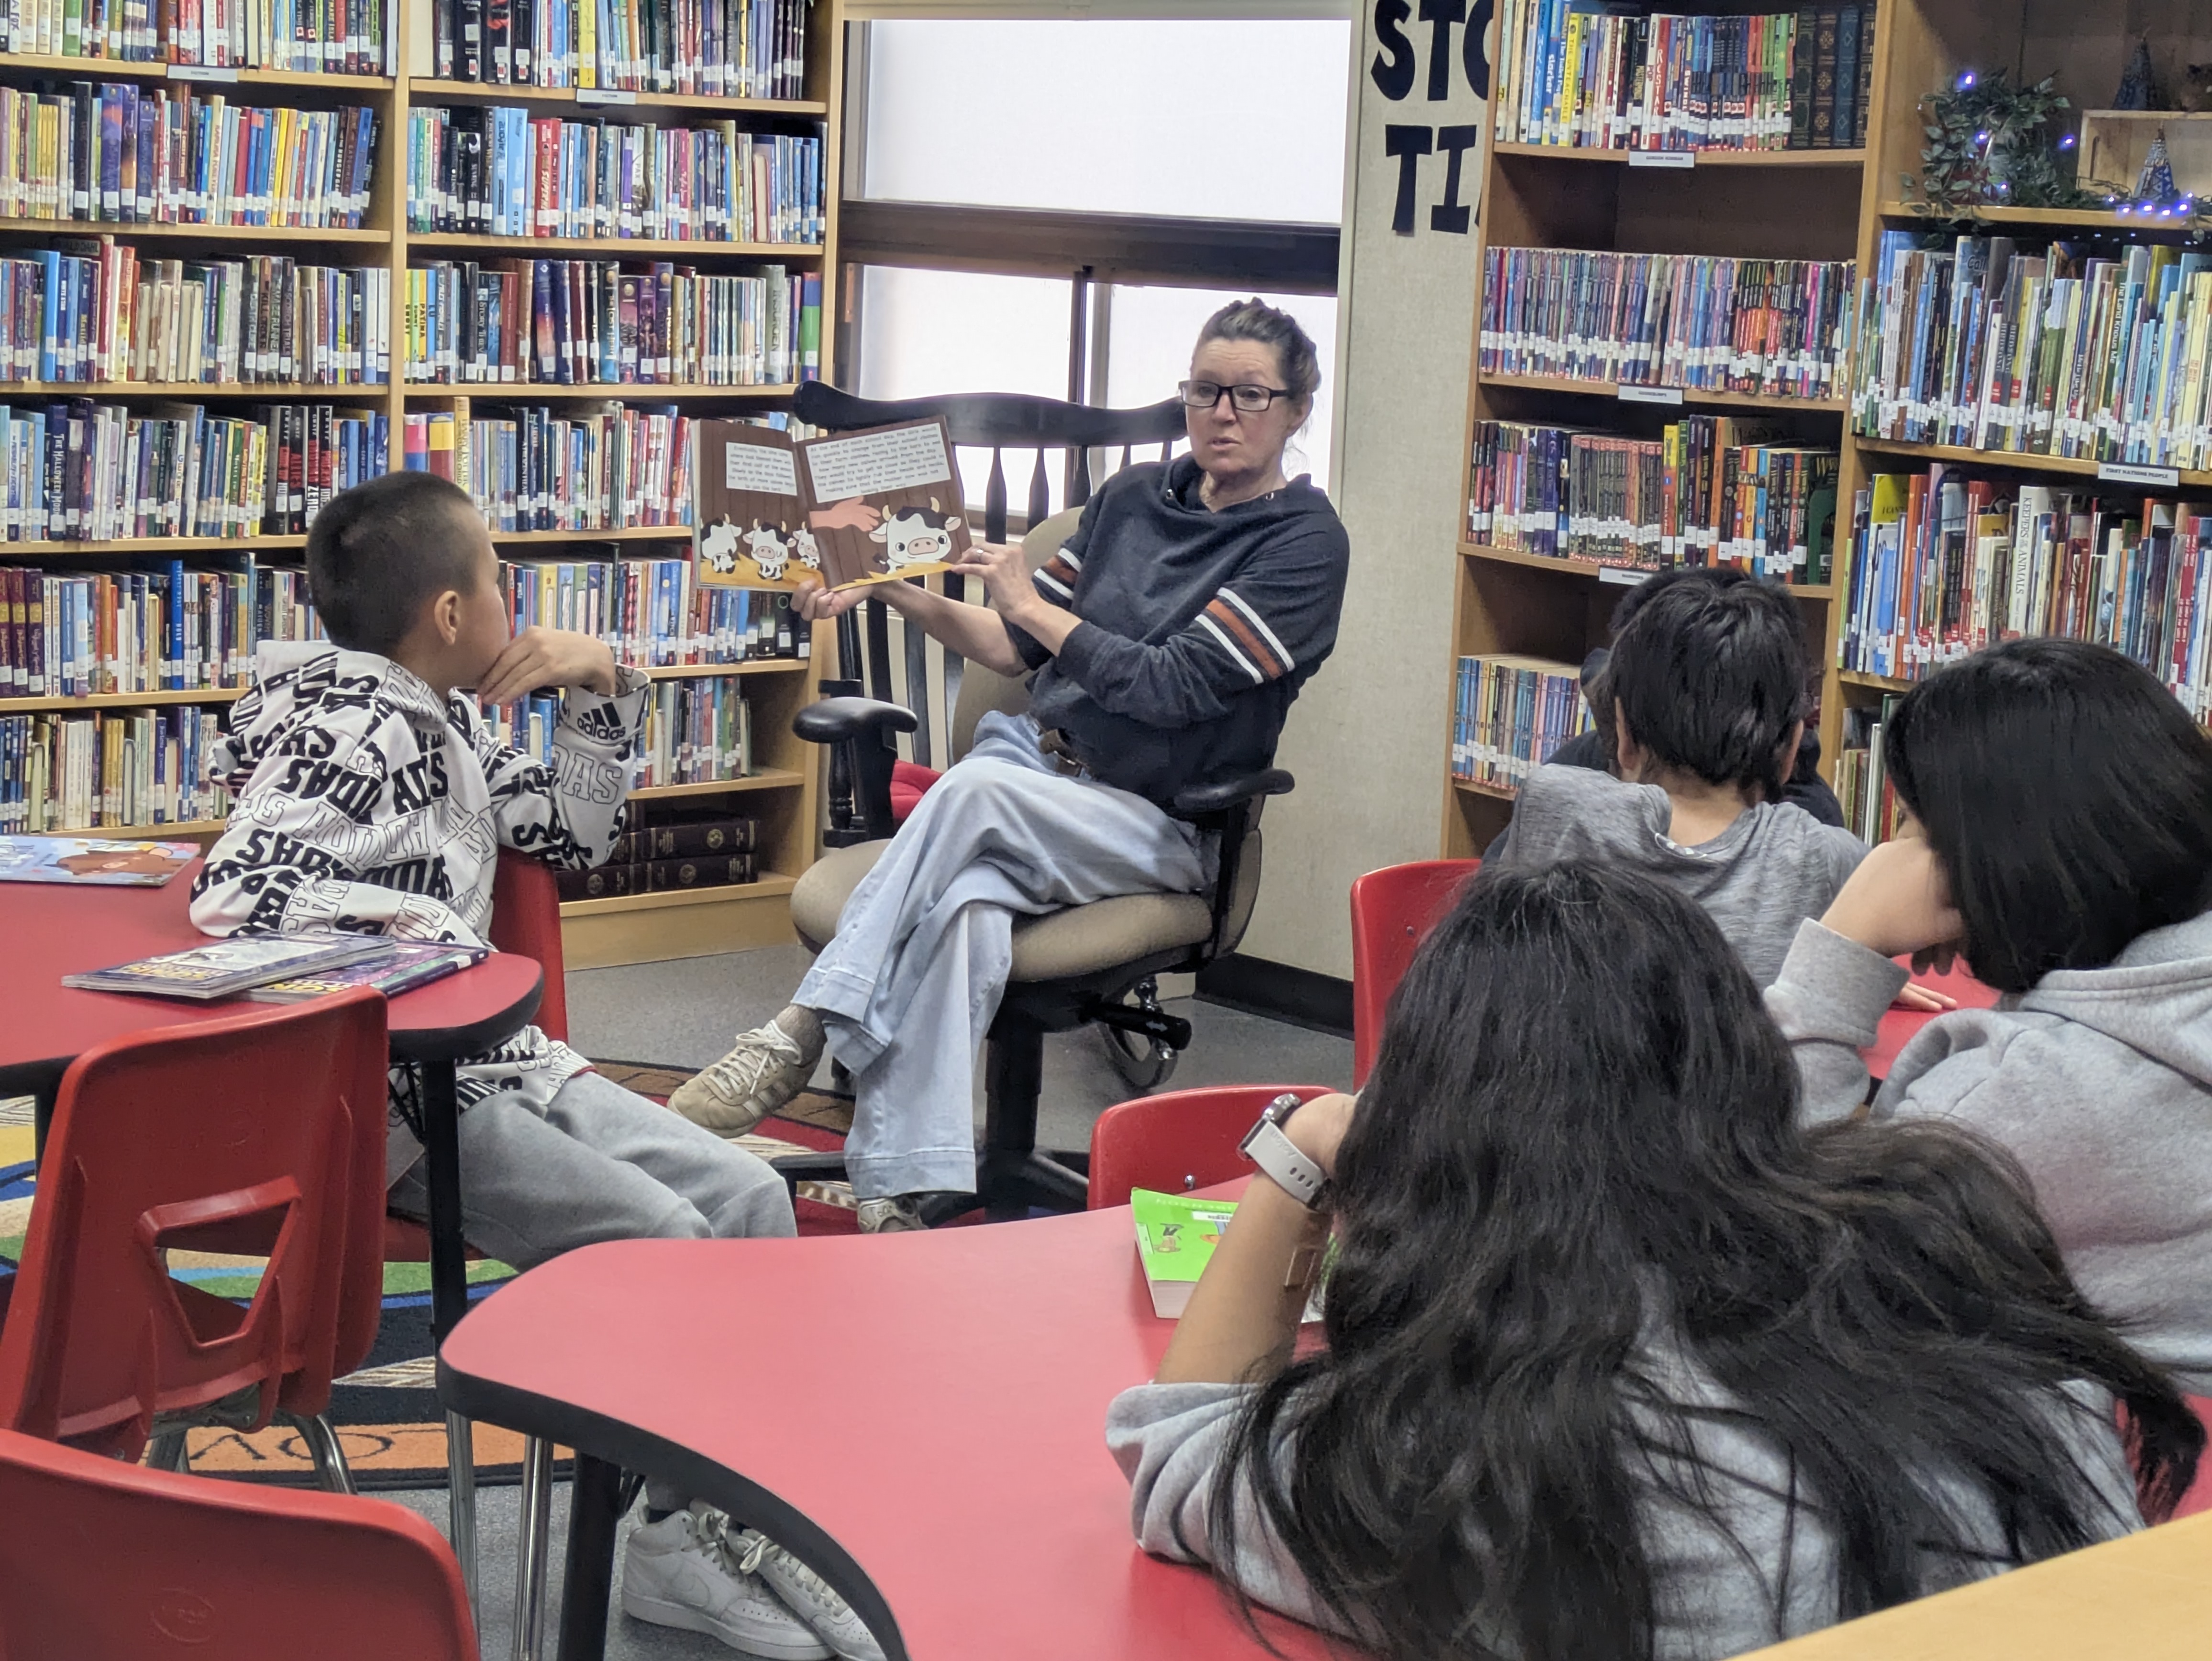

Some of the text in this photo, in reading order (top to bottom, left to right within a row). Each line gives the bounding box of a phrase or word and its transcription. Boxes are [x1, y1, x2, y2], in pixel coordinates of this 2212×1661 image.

[10, 13, 20, 31] FOX
[1546, 54, 1556, 94] slacker
[1562, 59, 1572, 119] UNTEACHABLE
[1385, 124, 1483, 237] TI
[260, 292, 268, 314] KILL
[429, 304, 435, 317] LU
[478, 301, 486, 327] STORY
[2115, 298, 2124, 319] Land
[283, 328, 291, 355] TRIALS
[2111, 321, 2122, 349] Knows
[2110, 351, 2119, 364] Me
[53, 451, 64, 493] HALLOWEEN
[2122, 469, 2147, 477] NATIONS
[2148, 471, 2168, 479] PEOPLE
[307, 486, 318, 512] ZERO
[2015, 497, 2032, 595] KEEPERS ANIMALS
[577, 717, 626, 740] adidas
